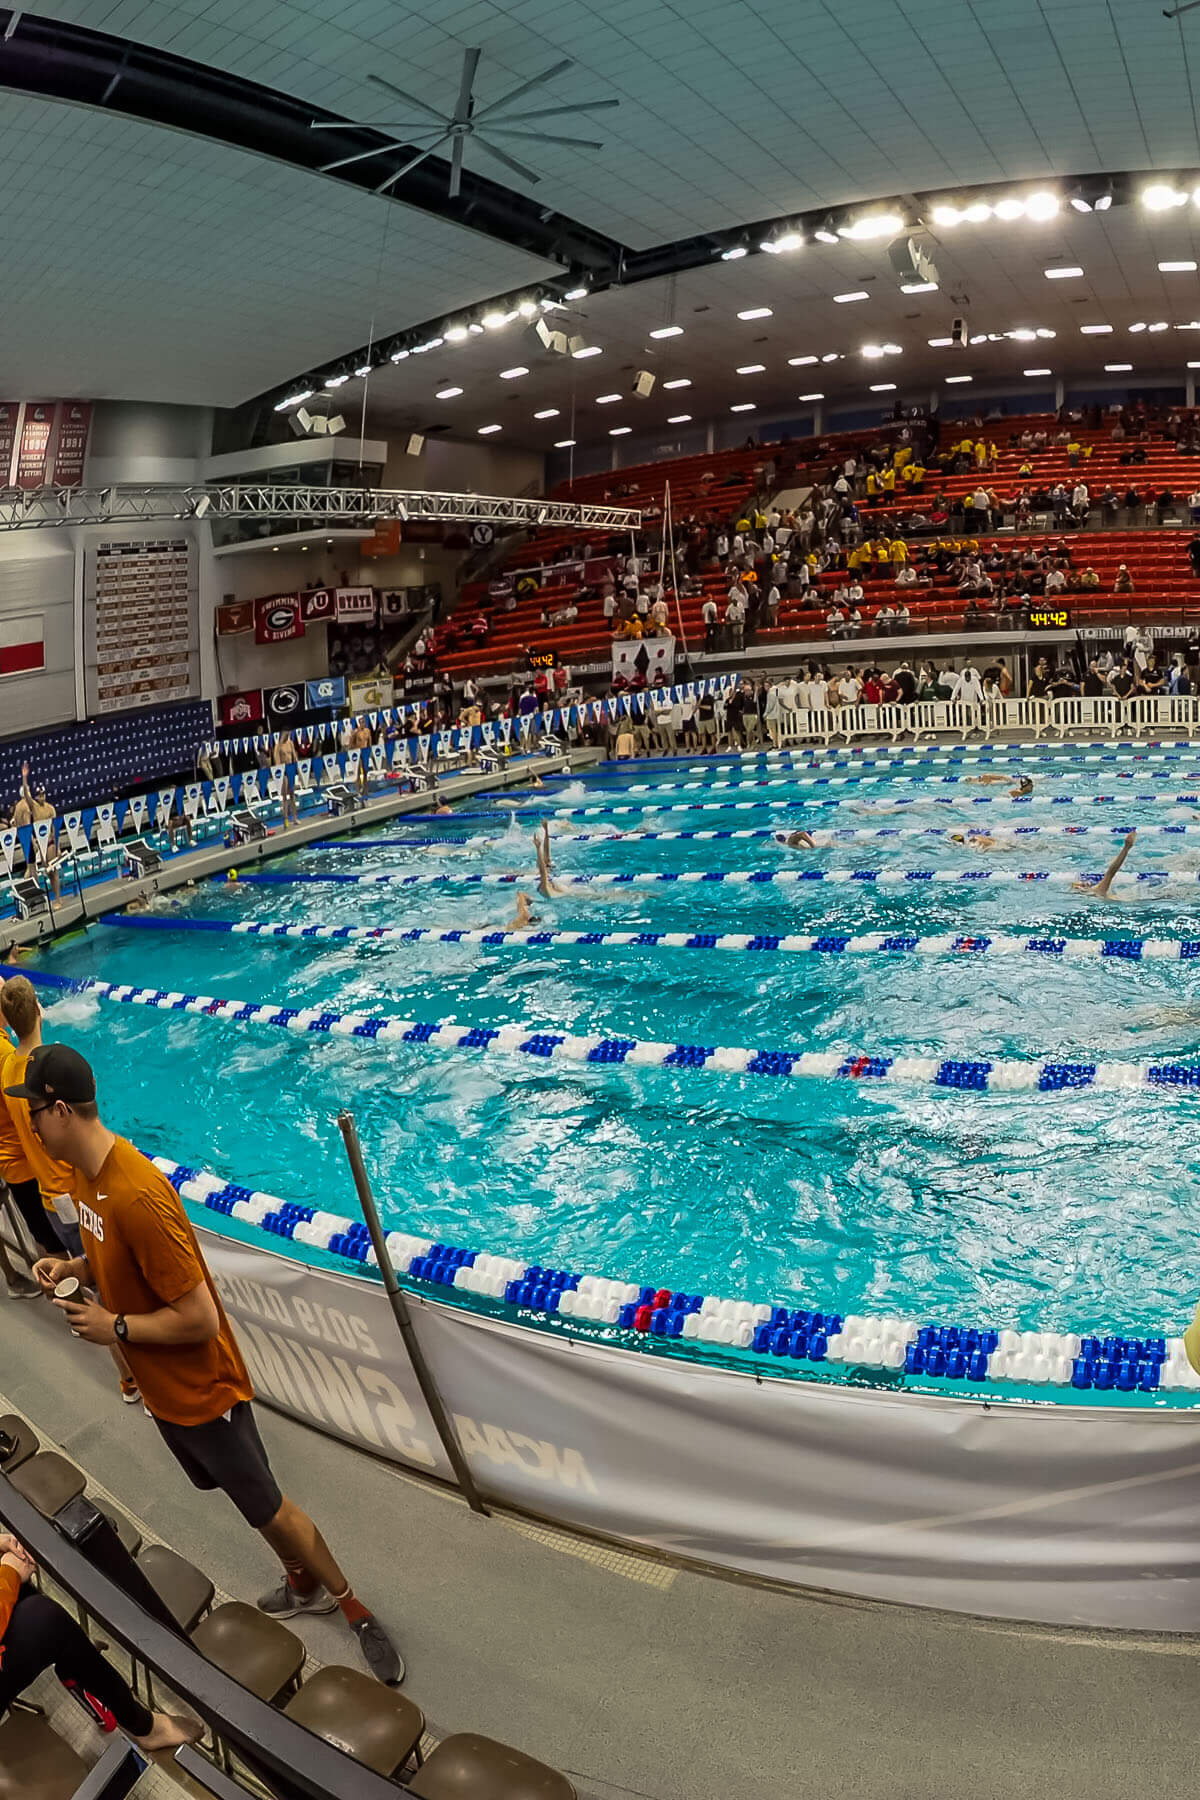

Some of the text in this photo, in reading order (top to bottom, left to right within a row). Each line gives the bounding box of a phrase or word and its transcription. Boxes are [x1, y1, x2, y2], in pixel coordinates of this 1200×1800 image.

[261, 598, 300, 614] SWIMMING
[1030, 611, 1068, 626] 44:42
[272, 627, 296, 640] DIVING
[78, 1200, 104, 1242] TEXAS
